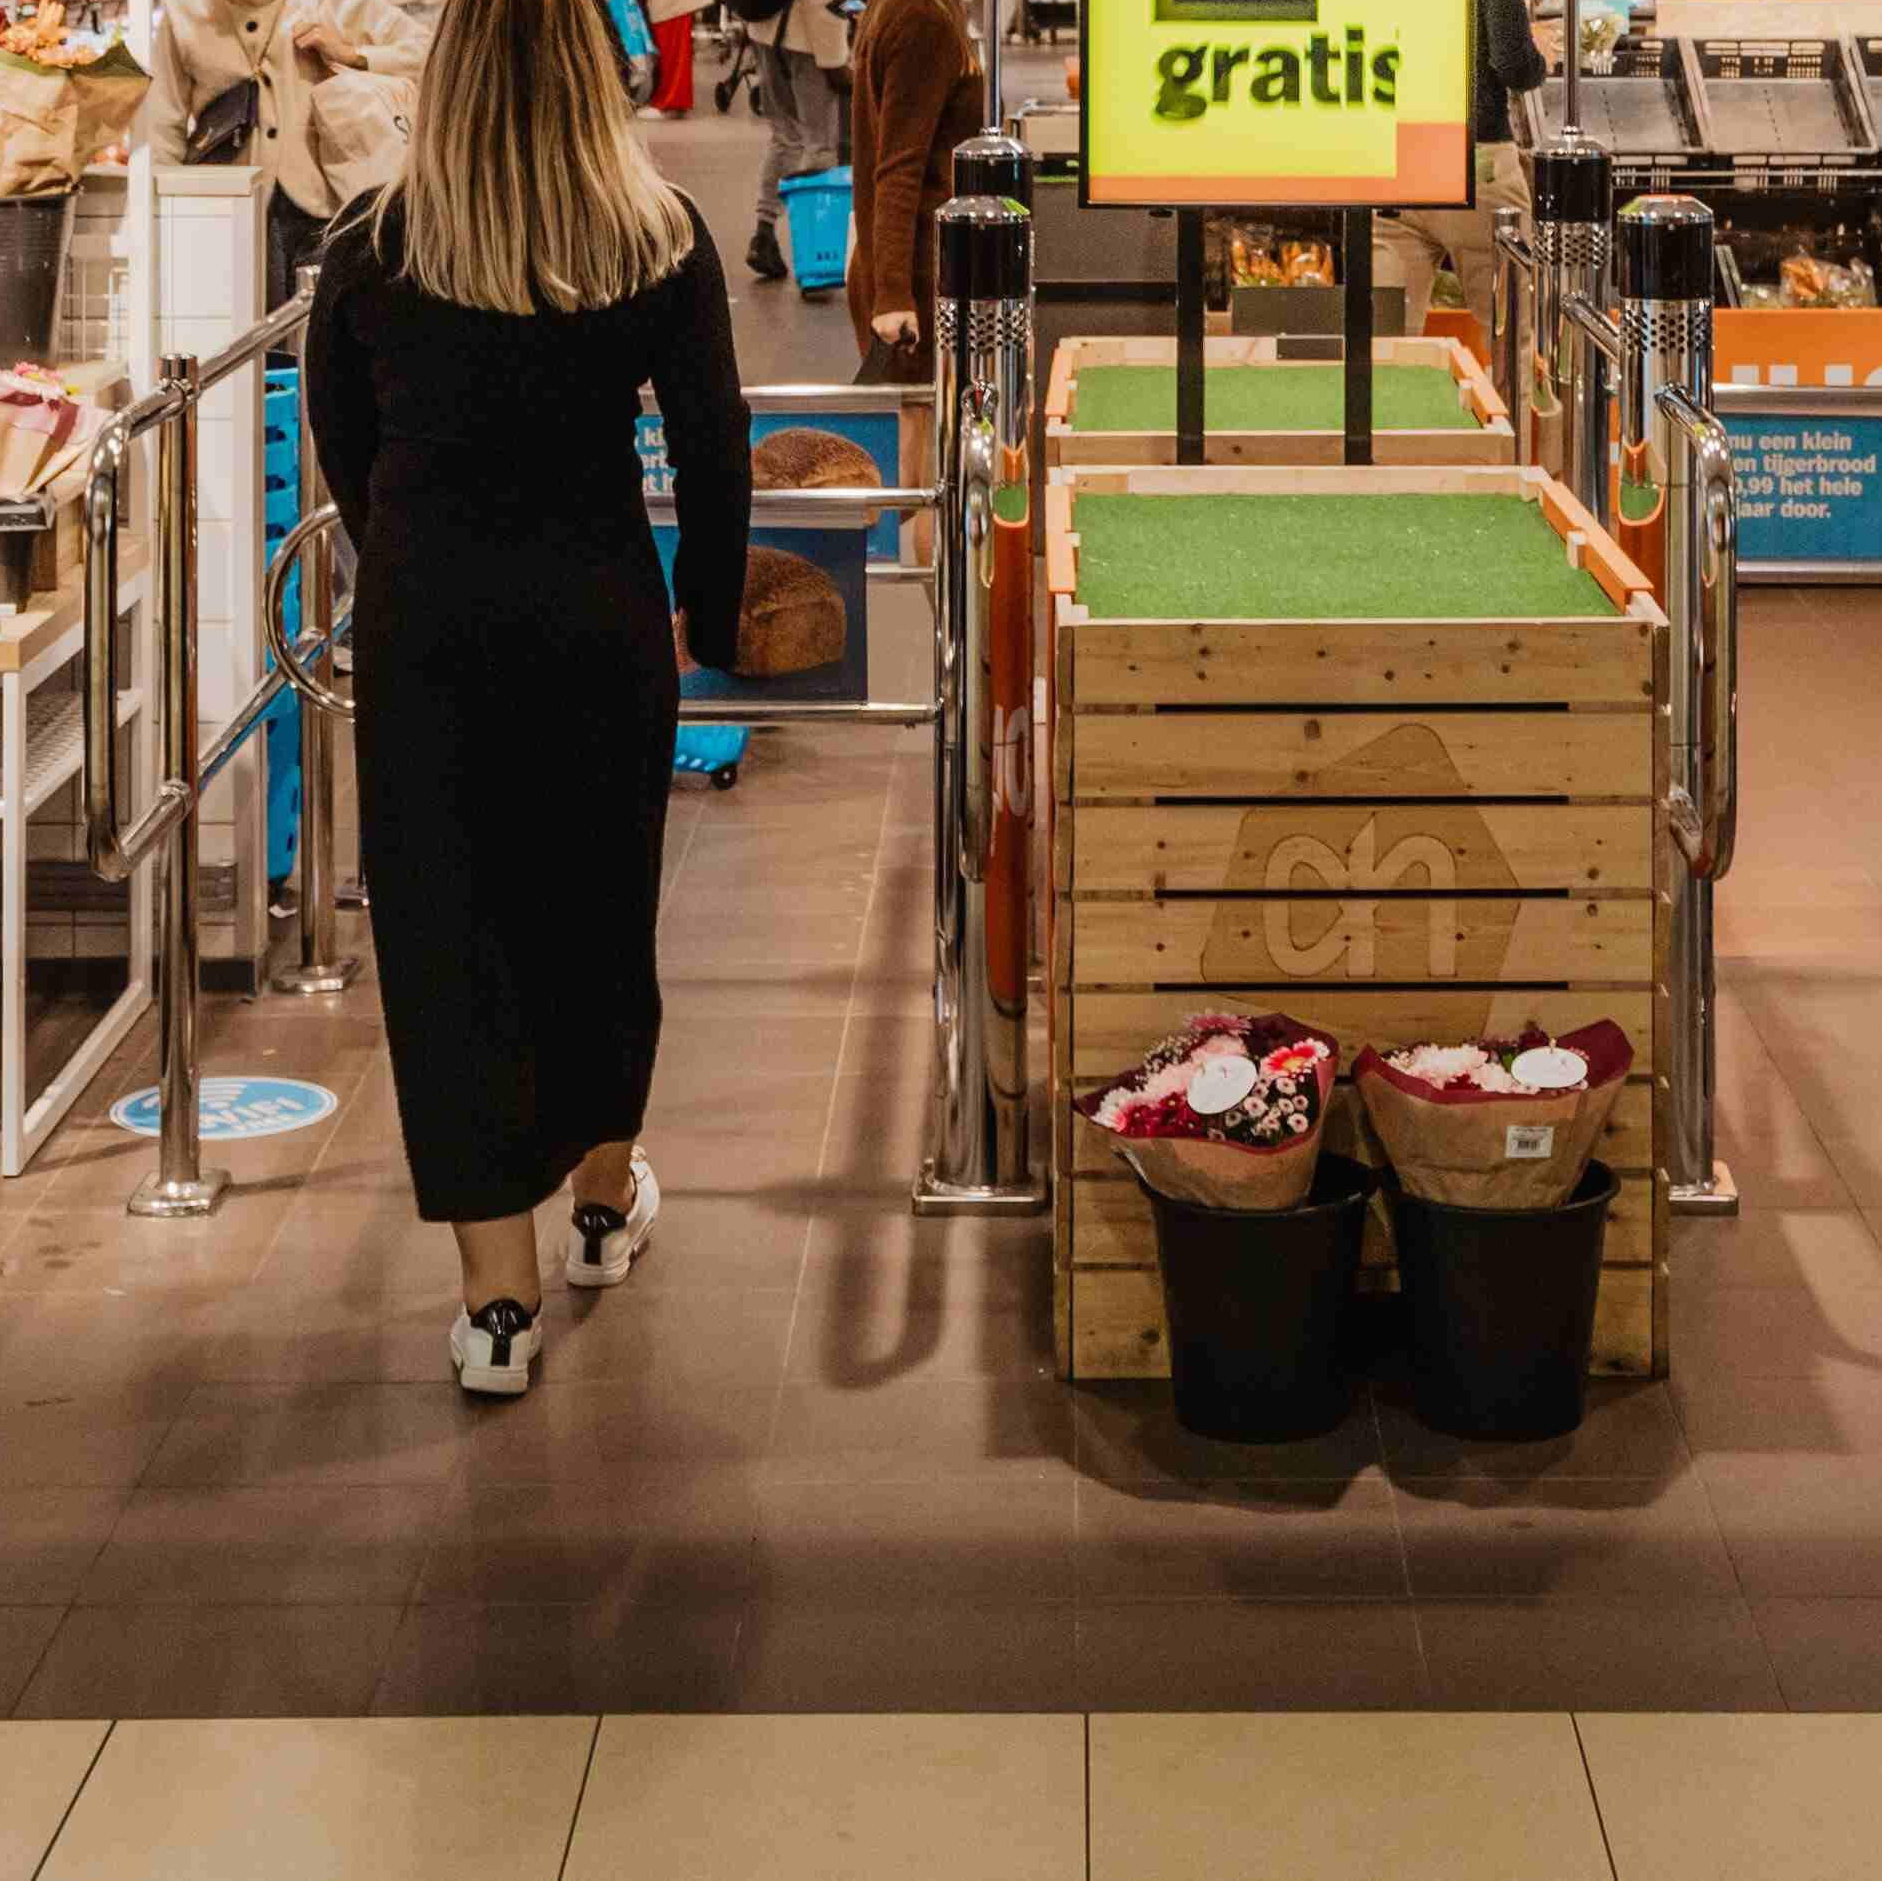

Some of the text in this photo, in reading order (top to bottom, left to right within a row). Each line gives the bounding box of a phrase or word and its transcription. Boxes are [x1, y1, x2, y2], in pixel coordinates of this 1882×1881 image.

[1152, 26, 1399, 121] gratis
[1758, 433, 1797, 451] een
[1801, 430, 1853, 451] klein
[1762, 453, 1877, 477] tijgerbrood
[1780, 475, 1814, 496] het
[1819, 476, 1863, 497] hele
[1779, 498, 1832, 519] door.
